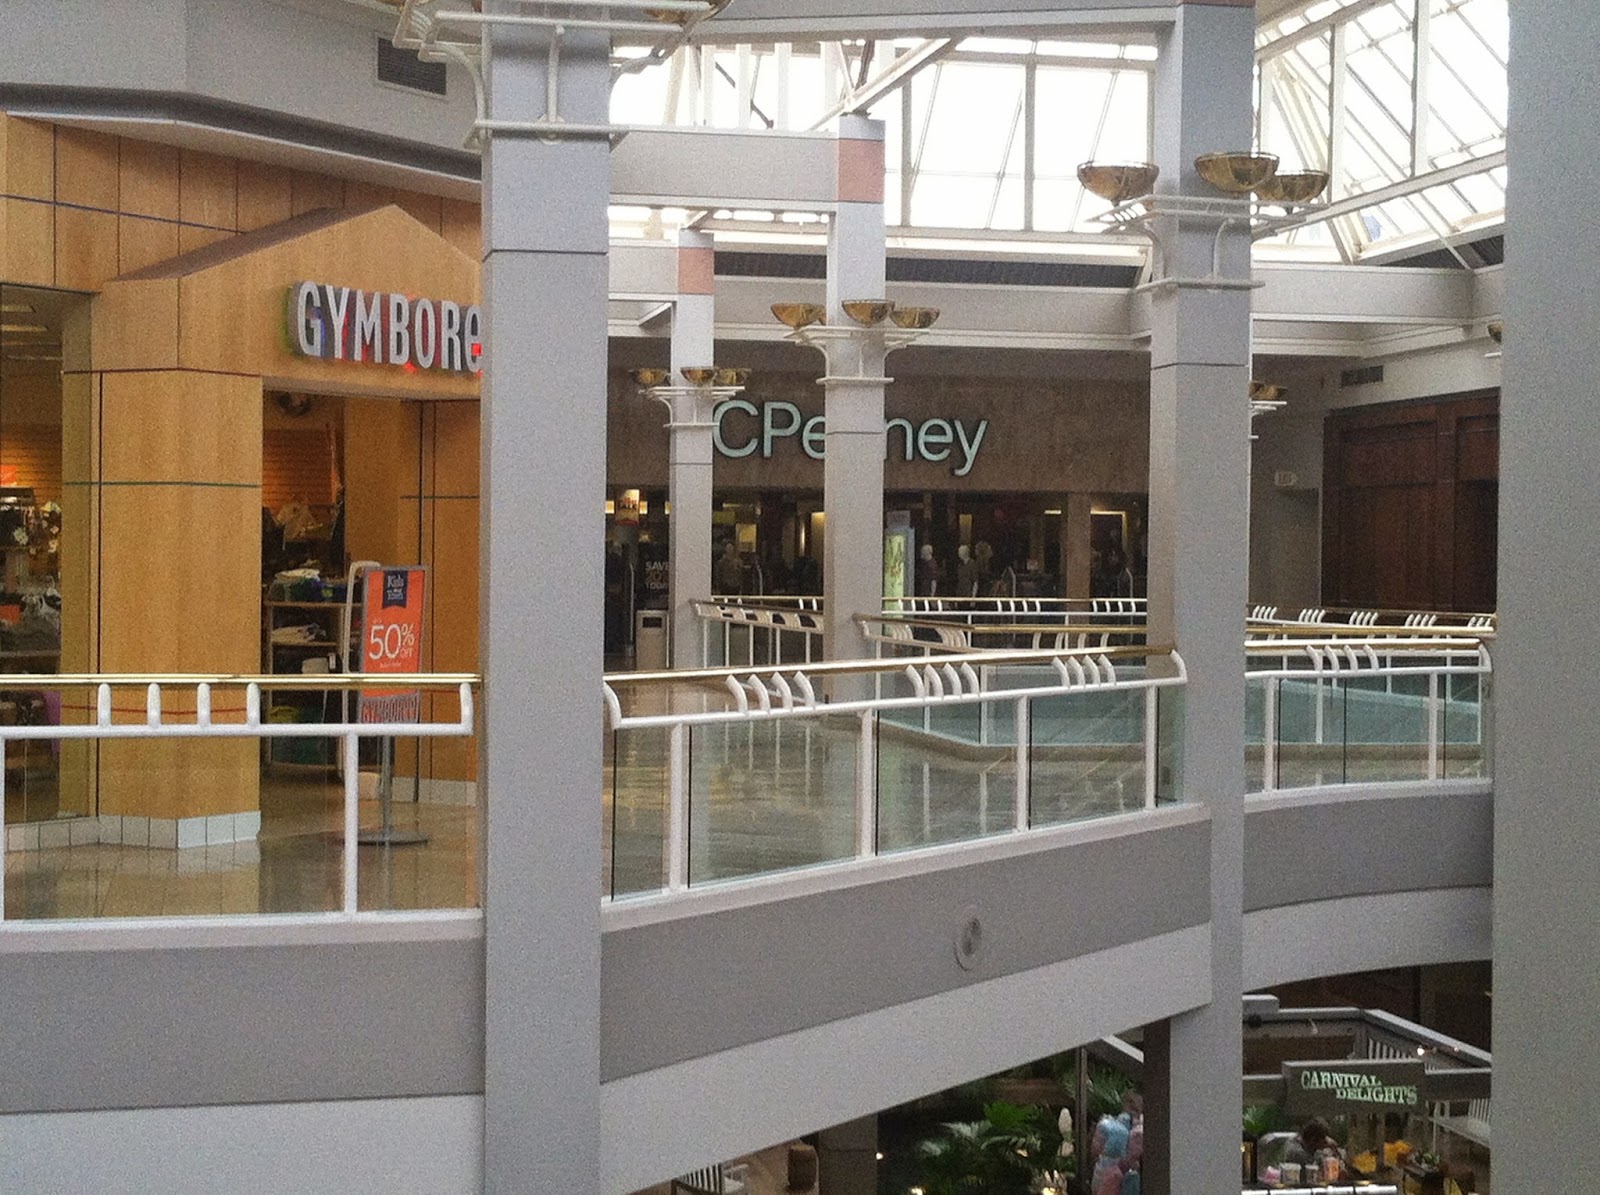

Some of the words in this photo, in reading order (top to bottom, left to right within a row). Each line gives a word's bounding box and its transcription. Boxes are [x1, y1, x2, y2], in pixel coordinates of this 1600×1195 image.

[297, 281, 482, 373] GYMBORe
[369, 623, 415, 660] 50%
[1301, 1071, 1382, 1089] CARNIVAL
[1336, 1086, 1418, 1105] DELIGHTS
